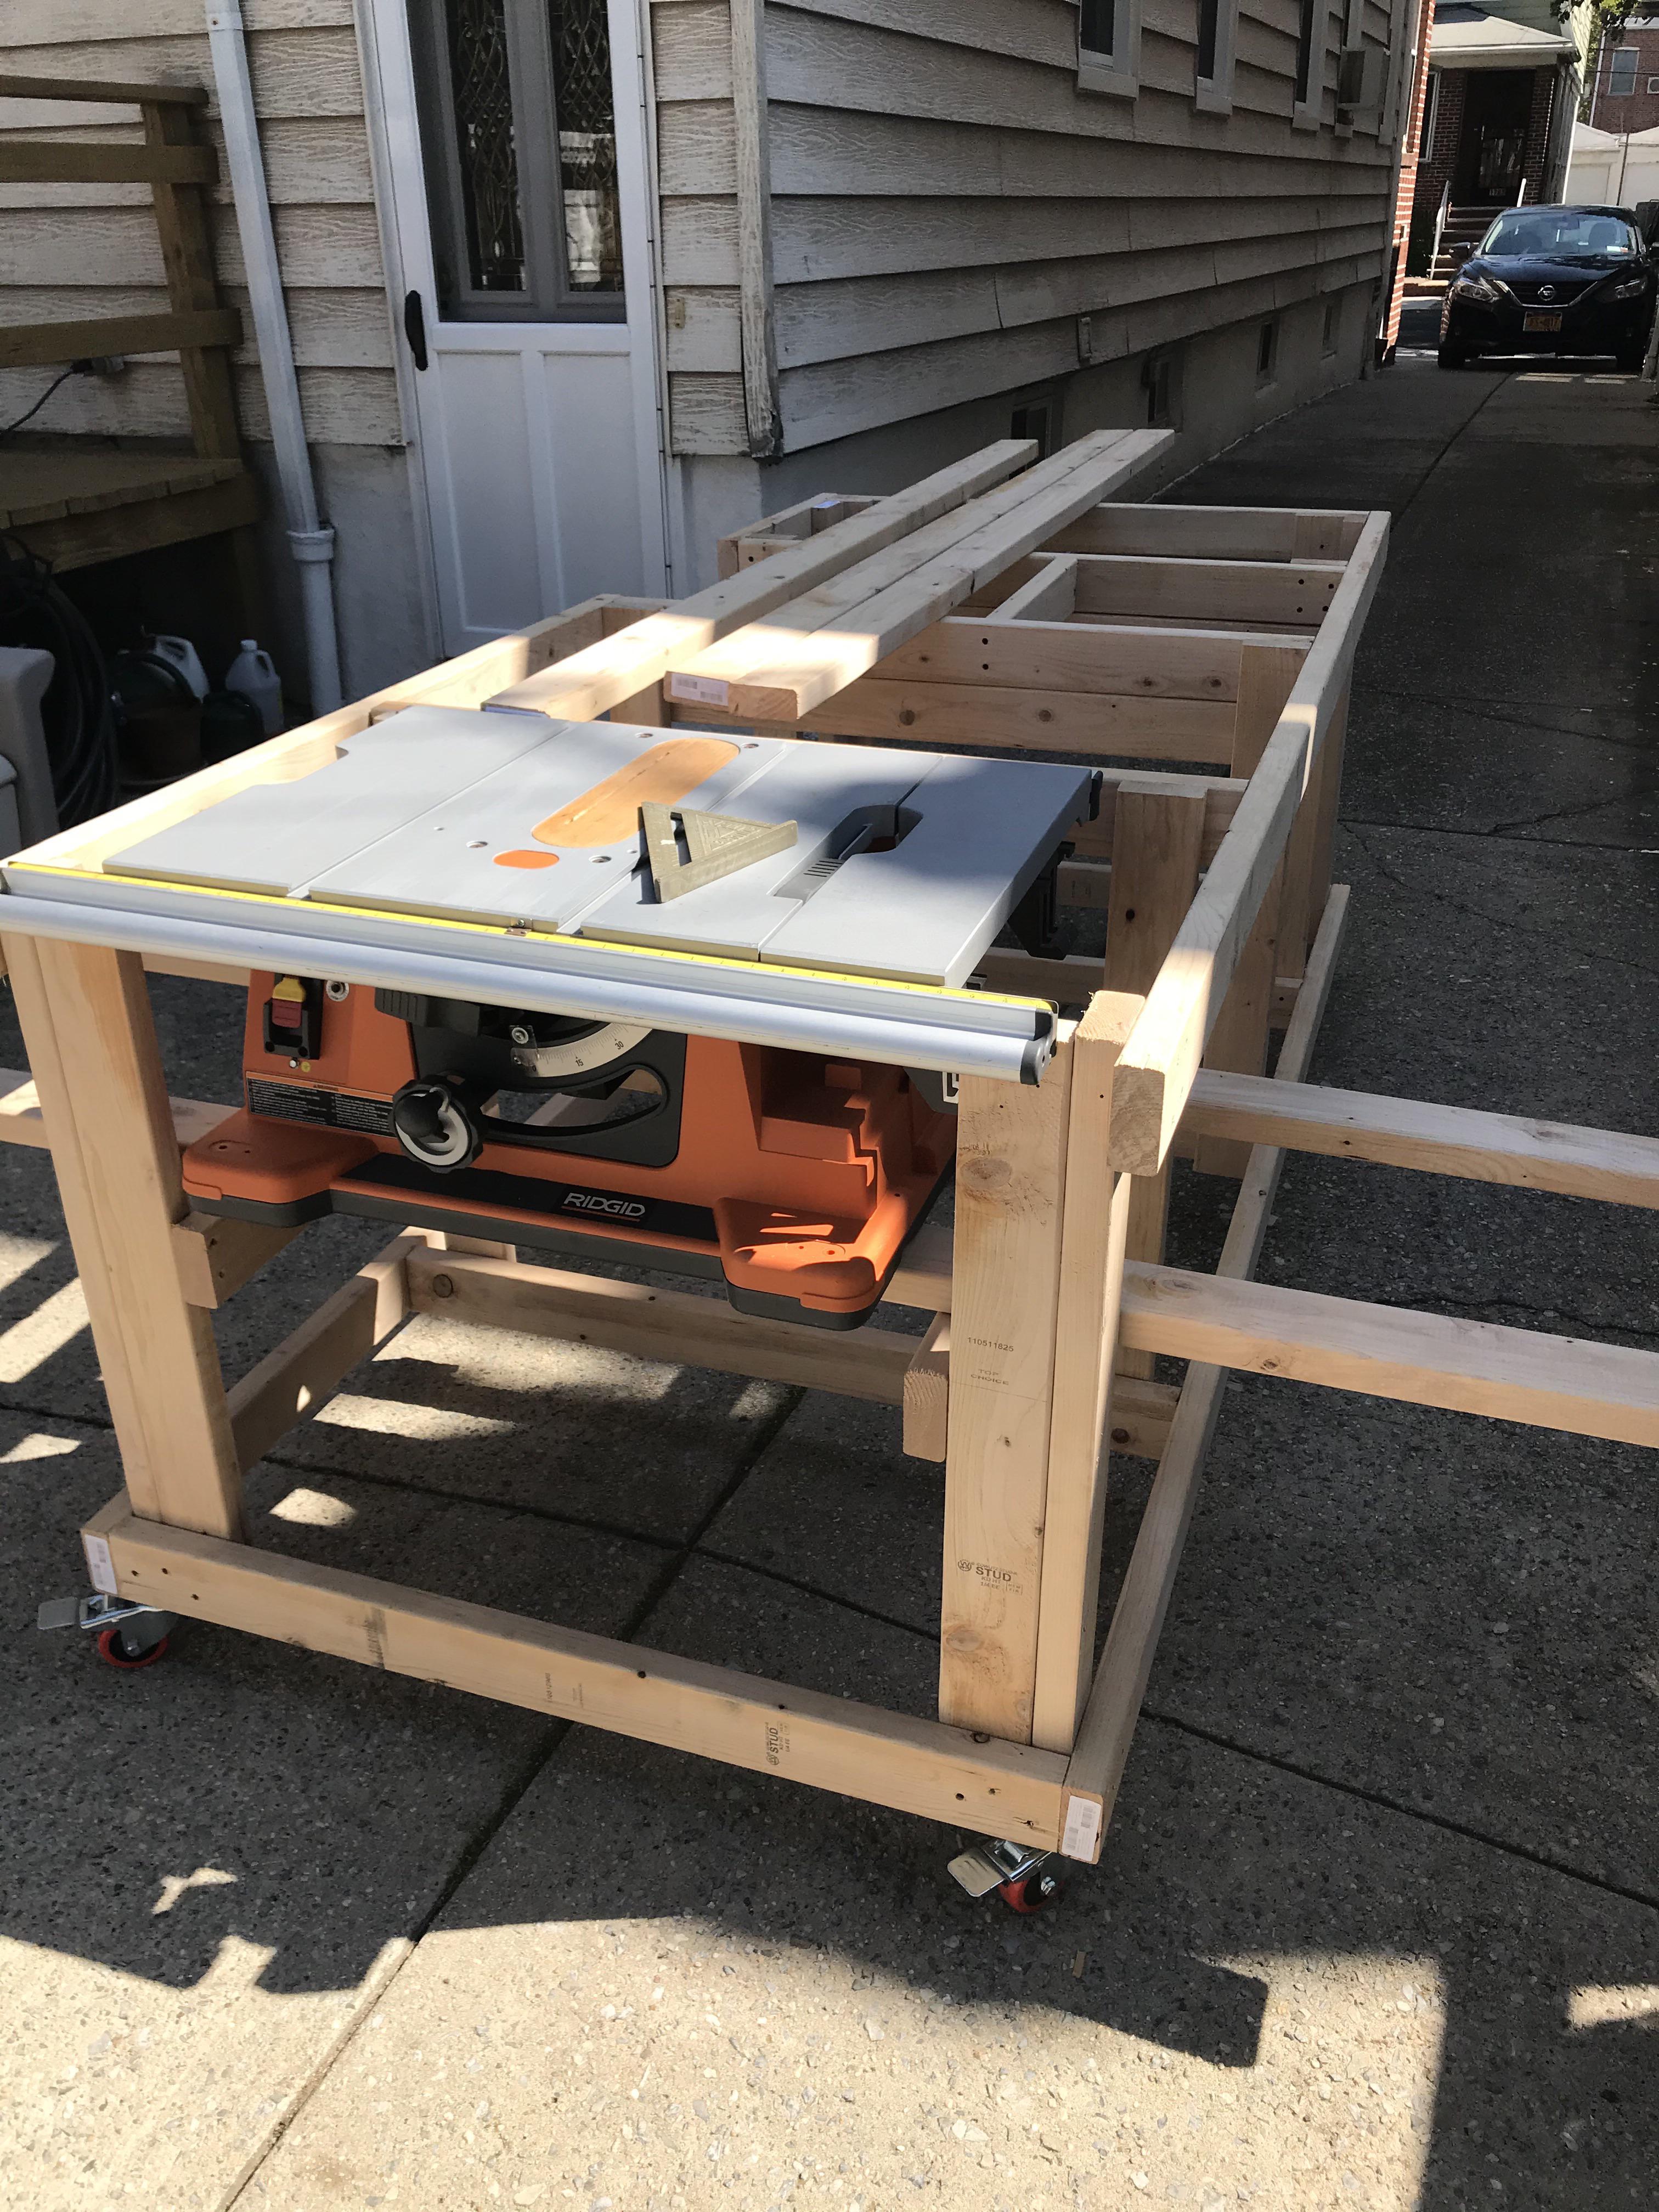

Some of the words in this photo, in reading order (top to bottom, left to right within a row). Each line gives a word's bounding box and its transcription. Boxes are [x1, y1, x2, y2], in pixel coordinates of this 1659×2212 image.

[615, 1041, 624, 1049] 30
[563, 1193, 646, 1216] RIDGID
[968, 1337, 1014, 1352] 110511825
[970, 1374, 1009, 1385] CHOICE
[976, 1566, 1011, 1581] STUD
[769, 1728, 778, 1753] STUD
